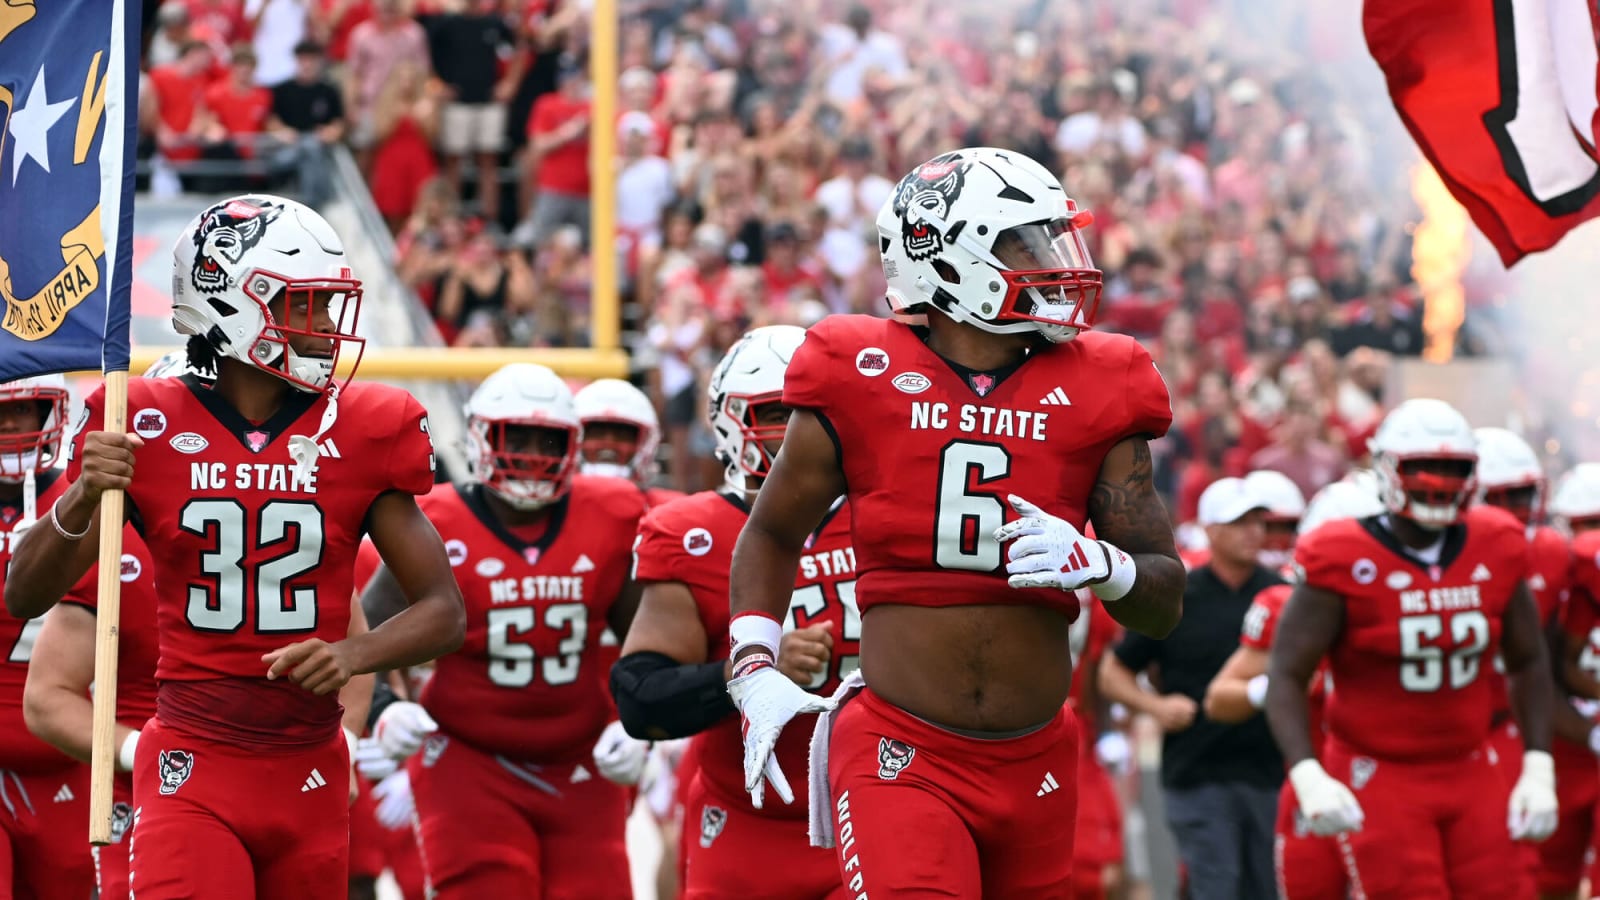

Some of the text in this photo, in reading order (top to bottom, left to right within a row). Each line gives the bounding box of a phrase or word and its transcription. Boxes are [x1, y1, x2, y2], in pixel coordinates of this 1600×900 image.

[899, 378, 924, 387] ACC
[911, 401, 1048, 441] NC STATE
[177, 437, 201, 446] ACC
[190, 462, 227, 491] NC
[933, 438, 1012, 573] 6
[180, 498, 326, 634] 32
[489, 575, 584, 604] NC STATE
[1429, 584, 1481, 612] STATE
[487, 603, 588, 687] 53
[1400, 611, 1490, 692] 52
